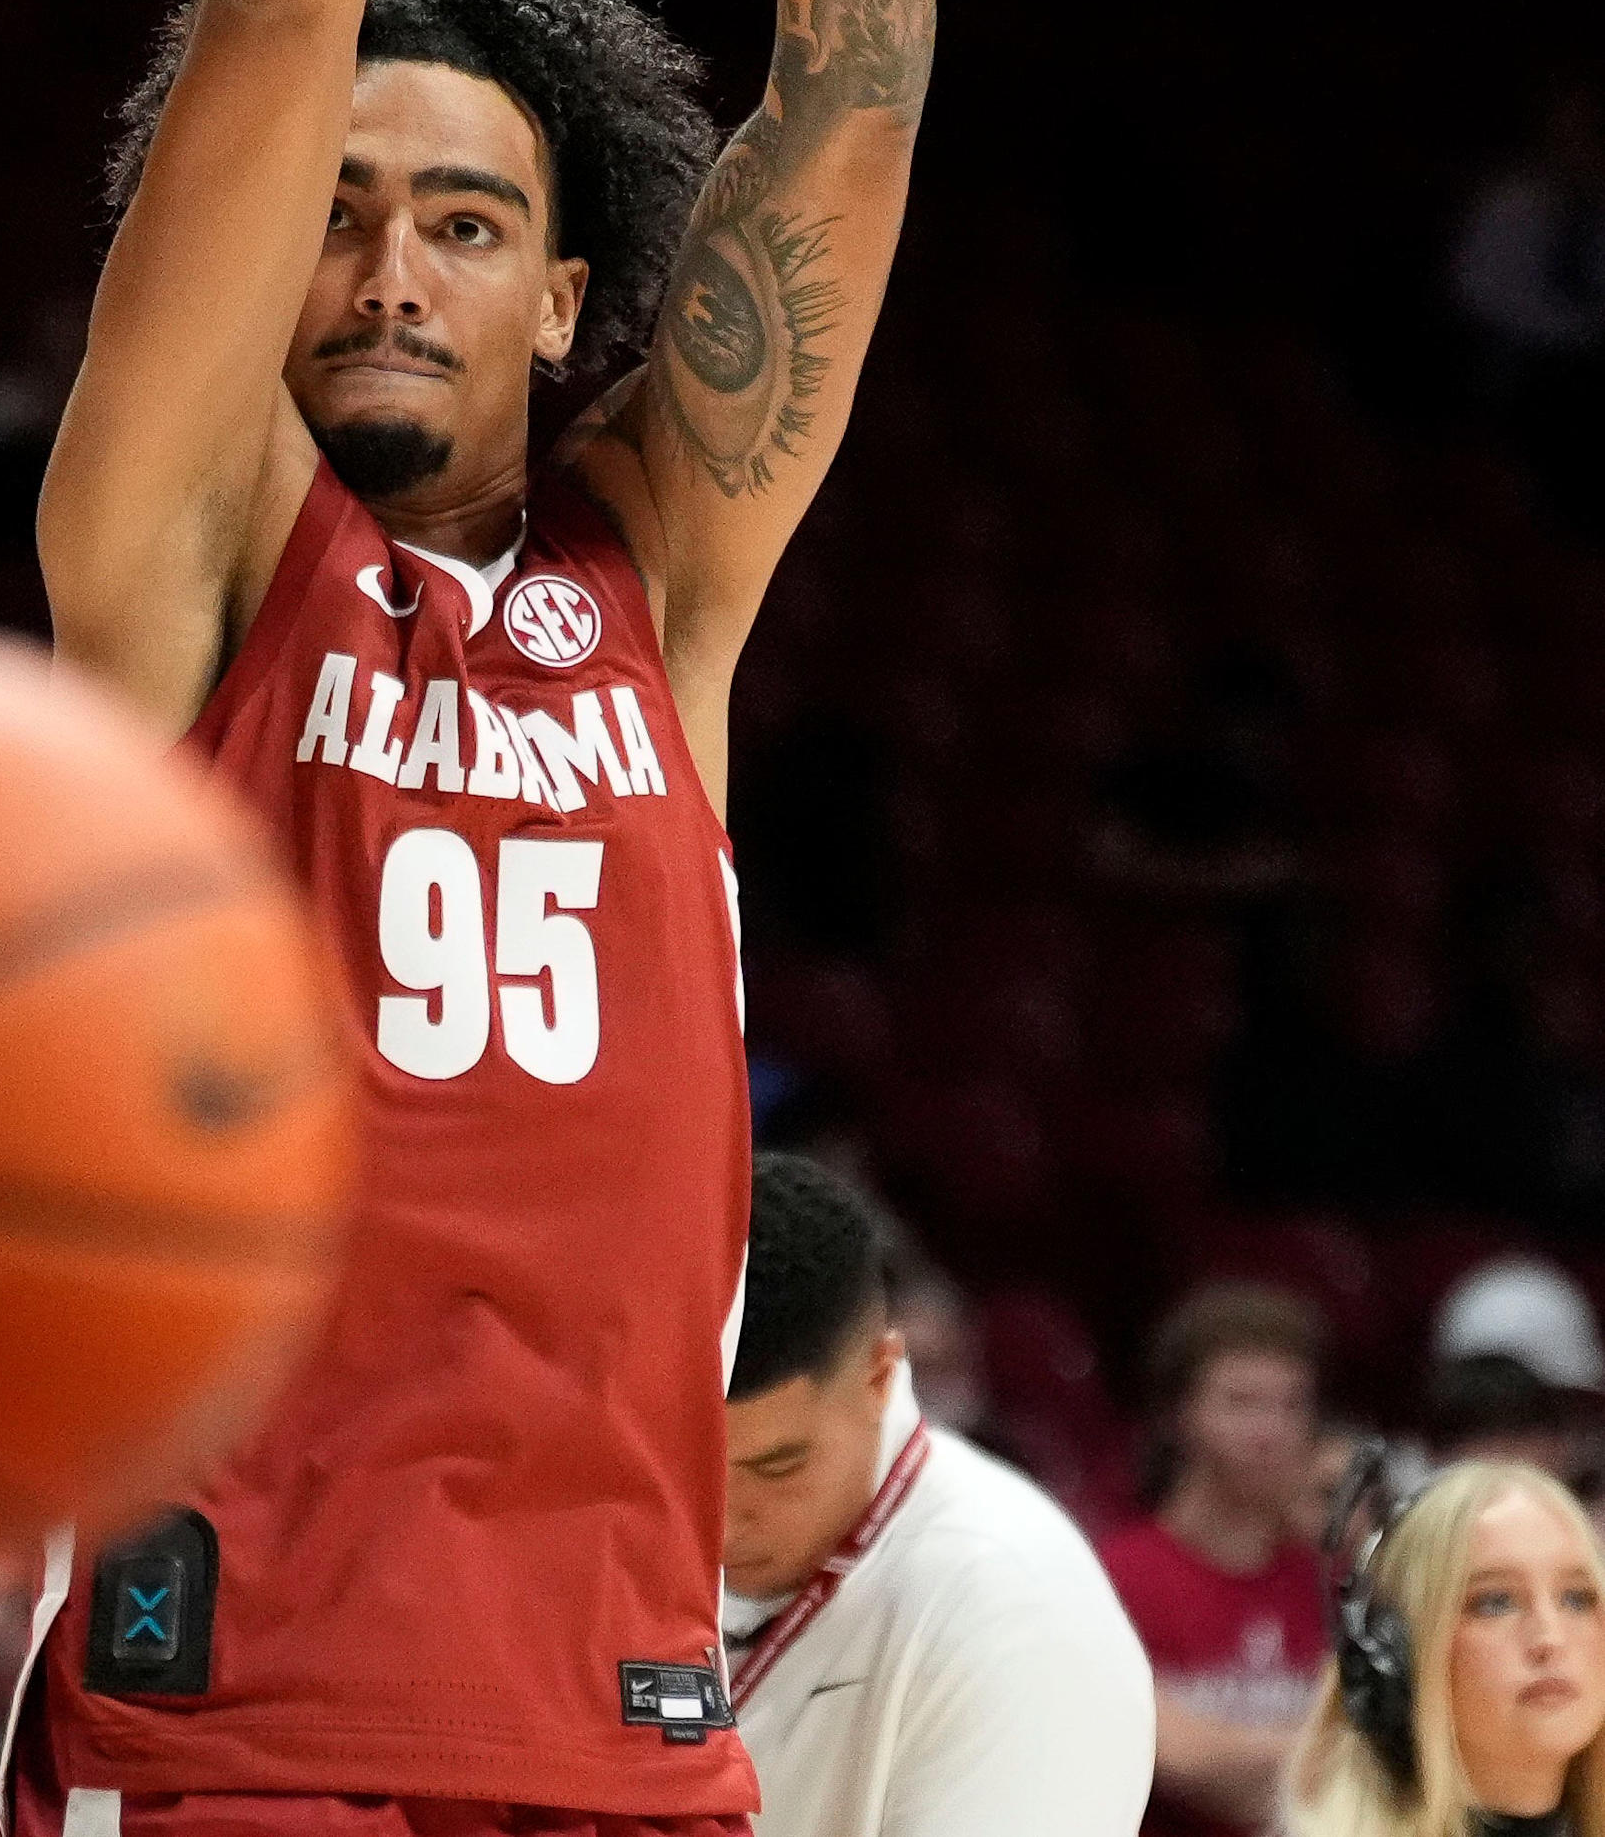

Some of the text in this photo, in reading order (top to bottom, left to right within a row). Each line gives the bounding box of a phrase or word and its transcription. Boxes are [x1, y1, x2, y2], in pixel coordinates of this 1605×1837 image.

[509, 582, 596, 661] SEC
[296, 652, 668, 814] ALABAMA
[377, 828, 605, 1085] 95
